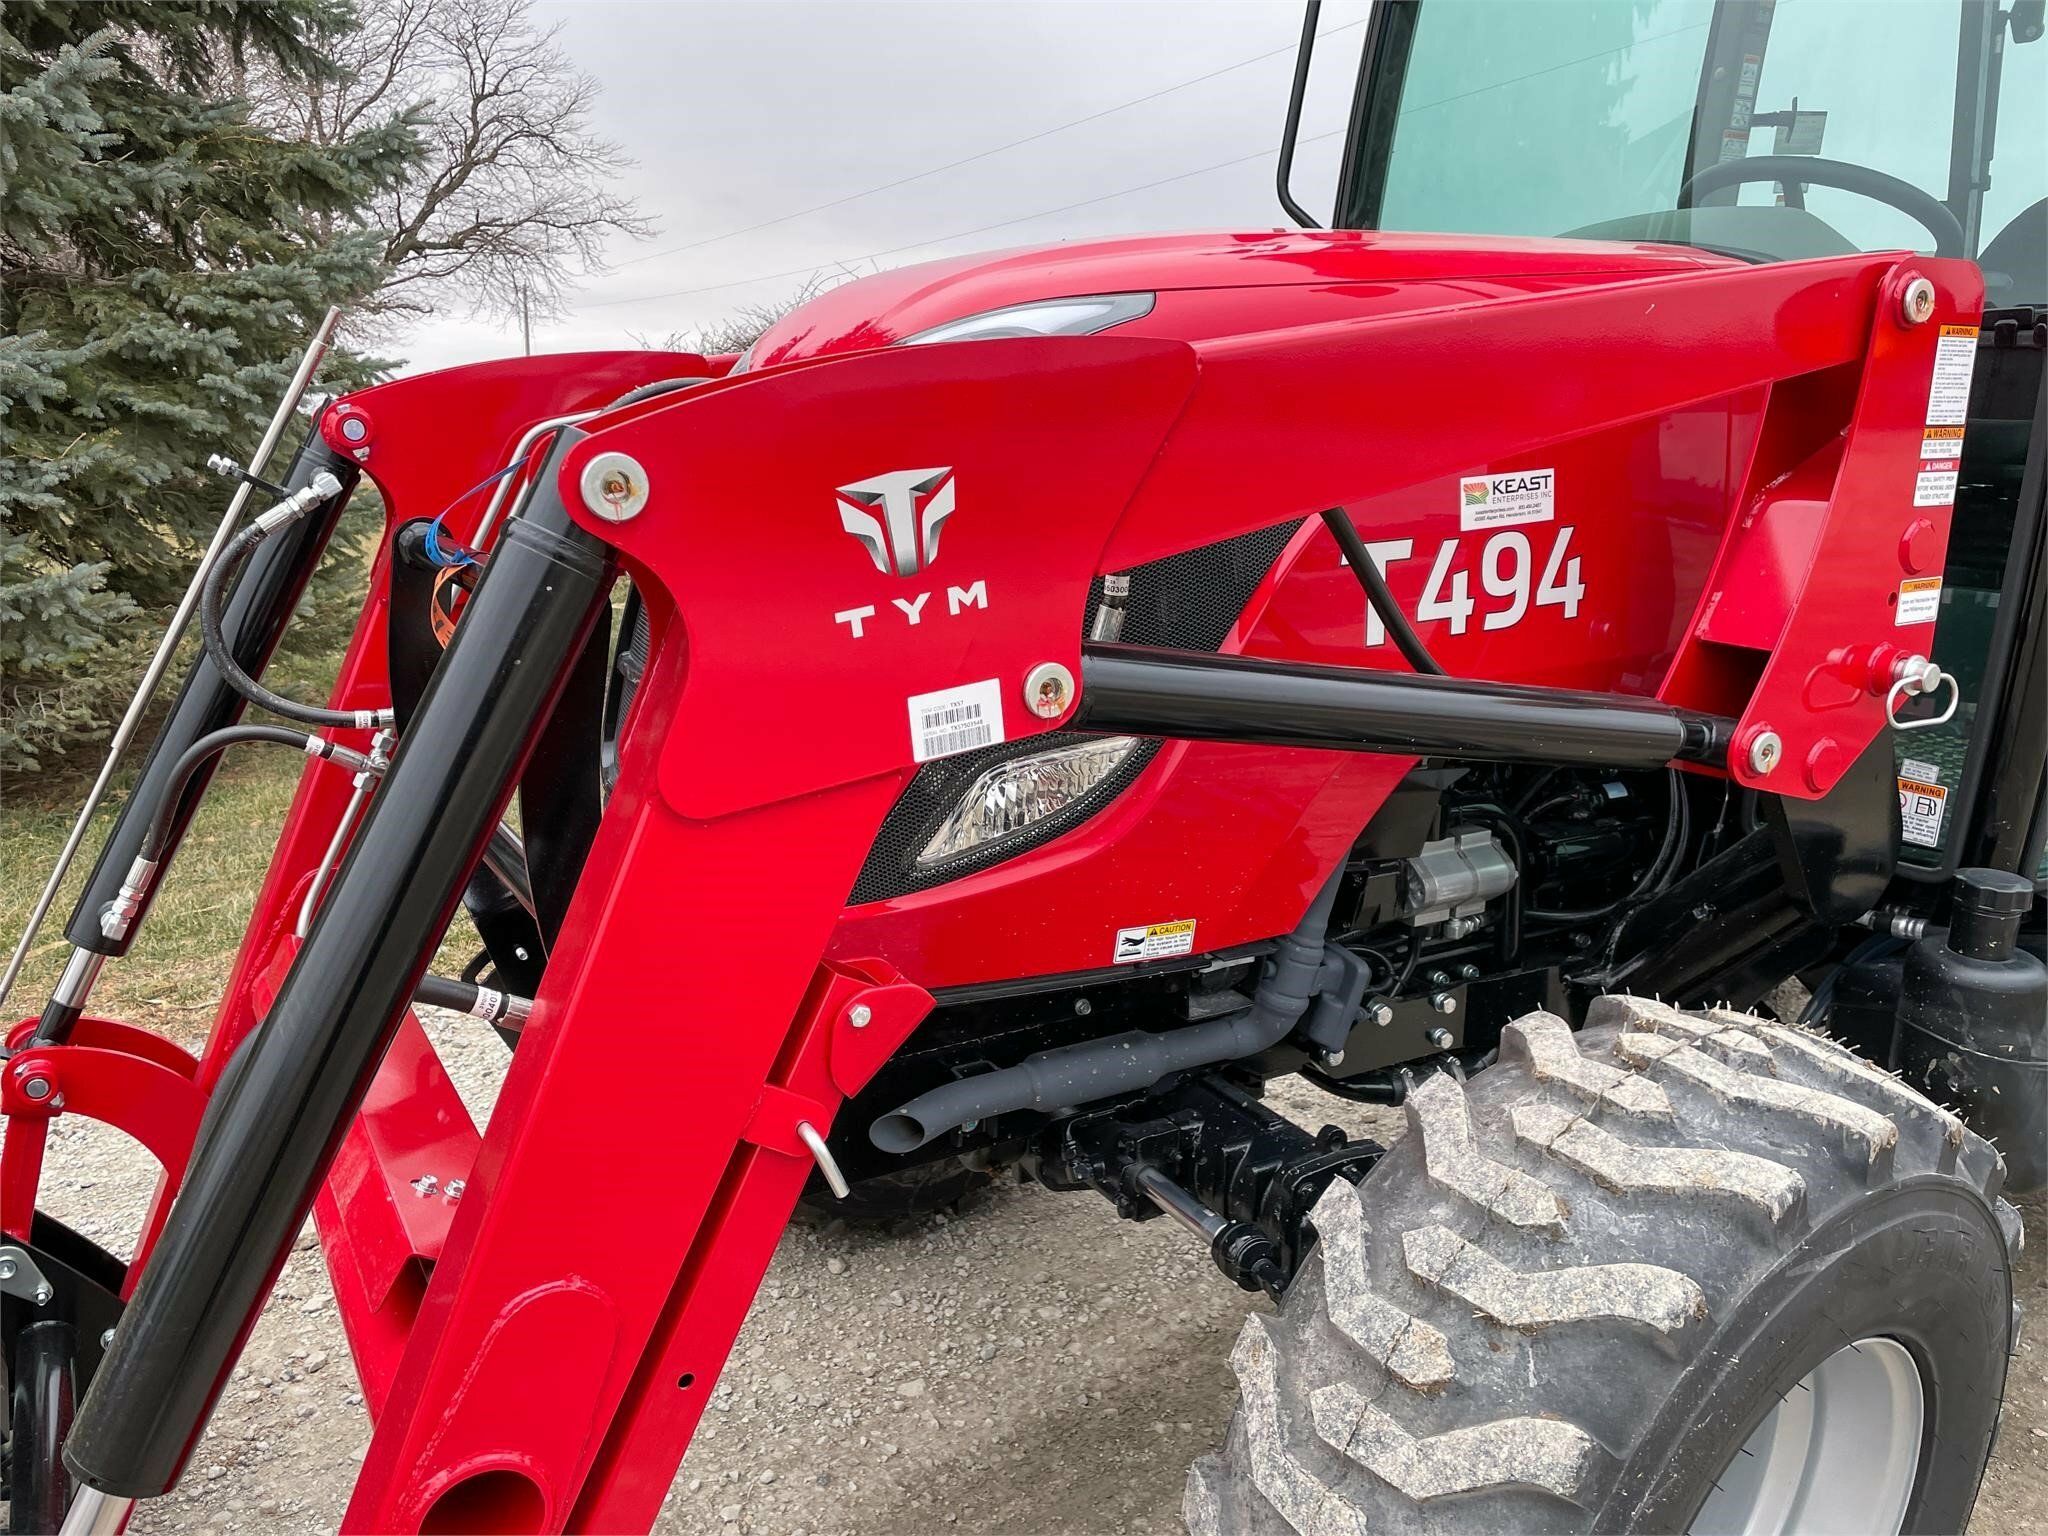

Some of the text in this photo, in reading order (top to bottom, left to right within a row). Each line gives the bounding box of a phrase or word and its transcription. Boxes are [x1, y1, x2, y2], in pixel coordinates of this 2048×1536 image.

[1951, 327, 1973, 336] WARNING
[1933, 429, 1962, 438] WARNING
[1492, 474, 1552, 496] KEAST
[1492, 490, 1552, 505] ENTERPRISES INC
[1340, 525, 1587, 648] T494
[834, 579, 989, 639] TYM
[1901, 781, 1942, 797] WARNING
[1159, 923, 1192, 934] CAUTION
